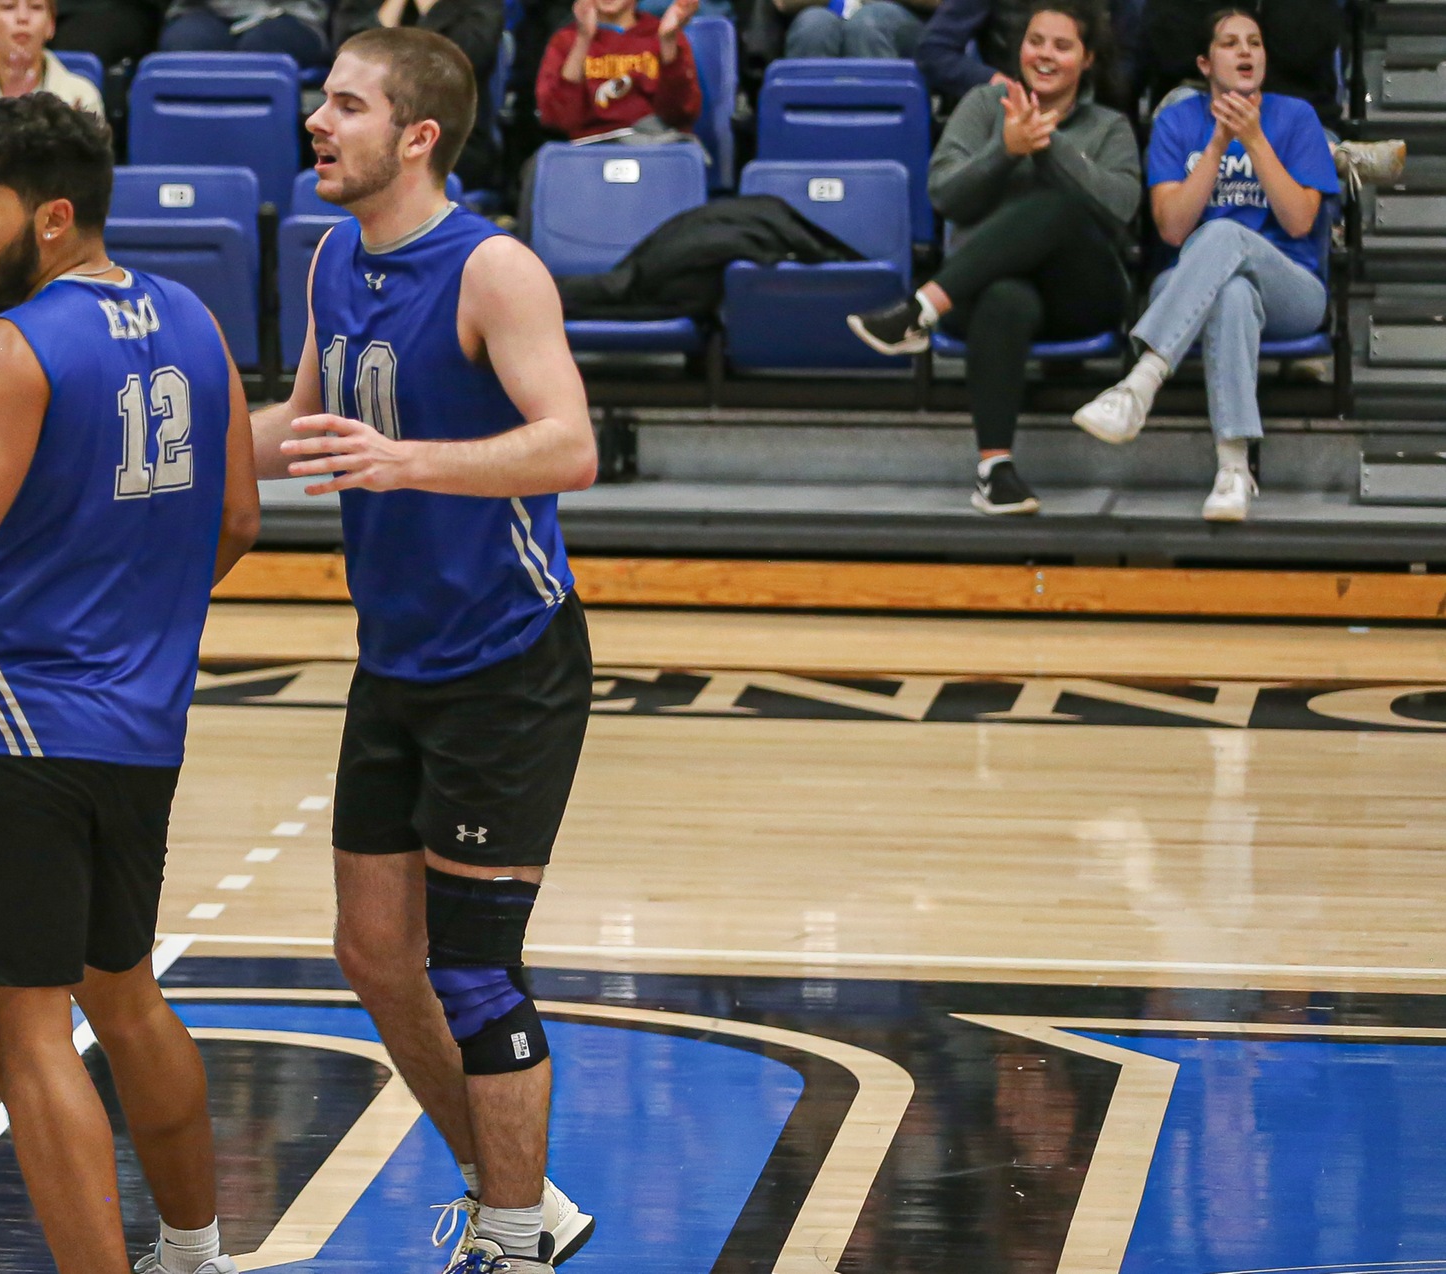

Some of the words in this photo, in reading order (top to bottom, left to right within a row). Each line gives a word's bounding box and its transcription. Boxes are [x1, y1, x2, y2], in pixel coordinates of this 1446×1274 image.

[98, 293, 160, 340] EMU
[114, 366, 194, 500] 12
[322, 334, 401, 440] 10
